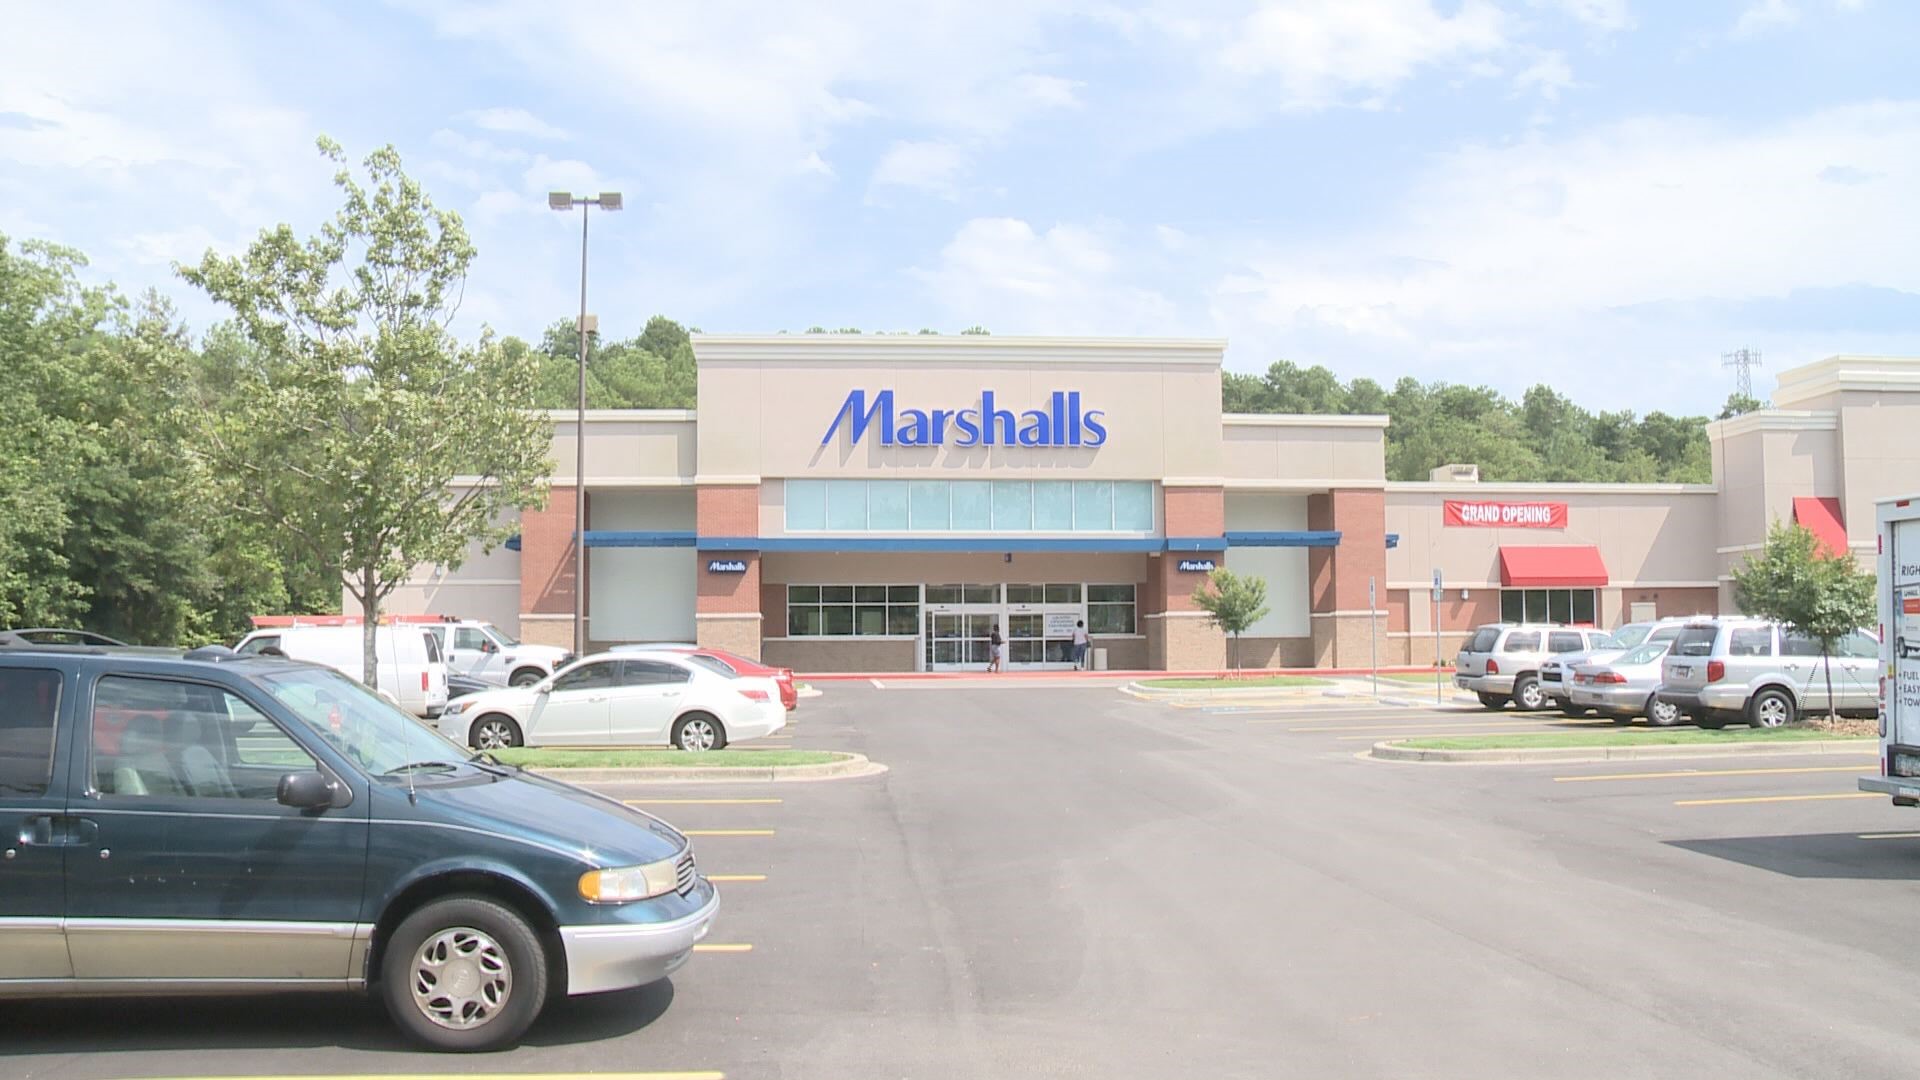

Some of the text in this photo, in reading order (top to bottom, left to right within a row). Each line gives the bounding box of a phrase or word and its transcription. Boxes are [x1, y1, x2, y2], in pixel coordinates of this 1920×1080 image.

[821, 389, 1107, 447] Marshalls
[1462, 504, 1551, 523] GRAND OPENING
[709, 561, 746, 571] Marshalls
[1903, 671, 1920, 681] FUEL
